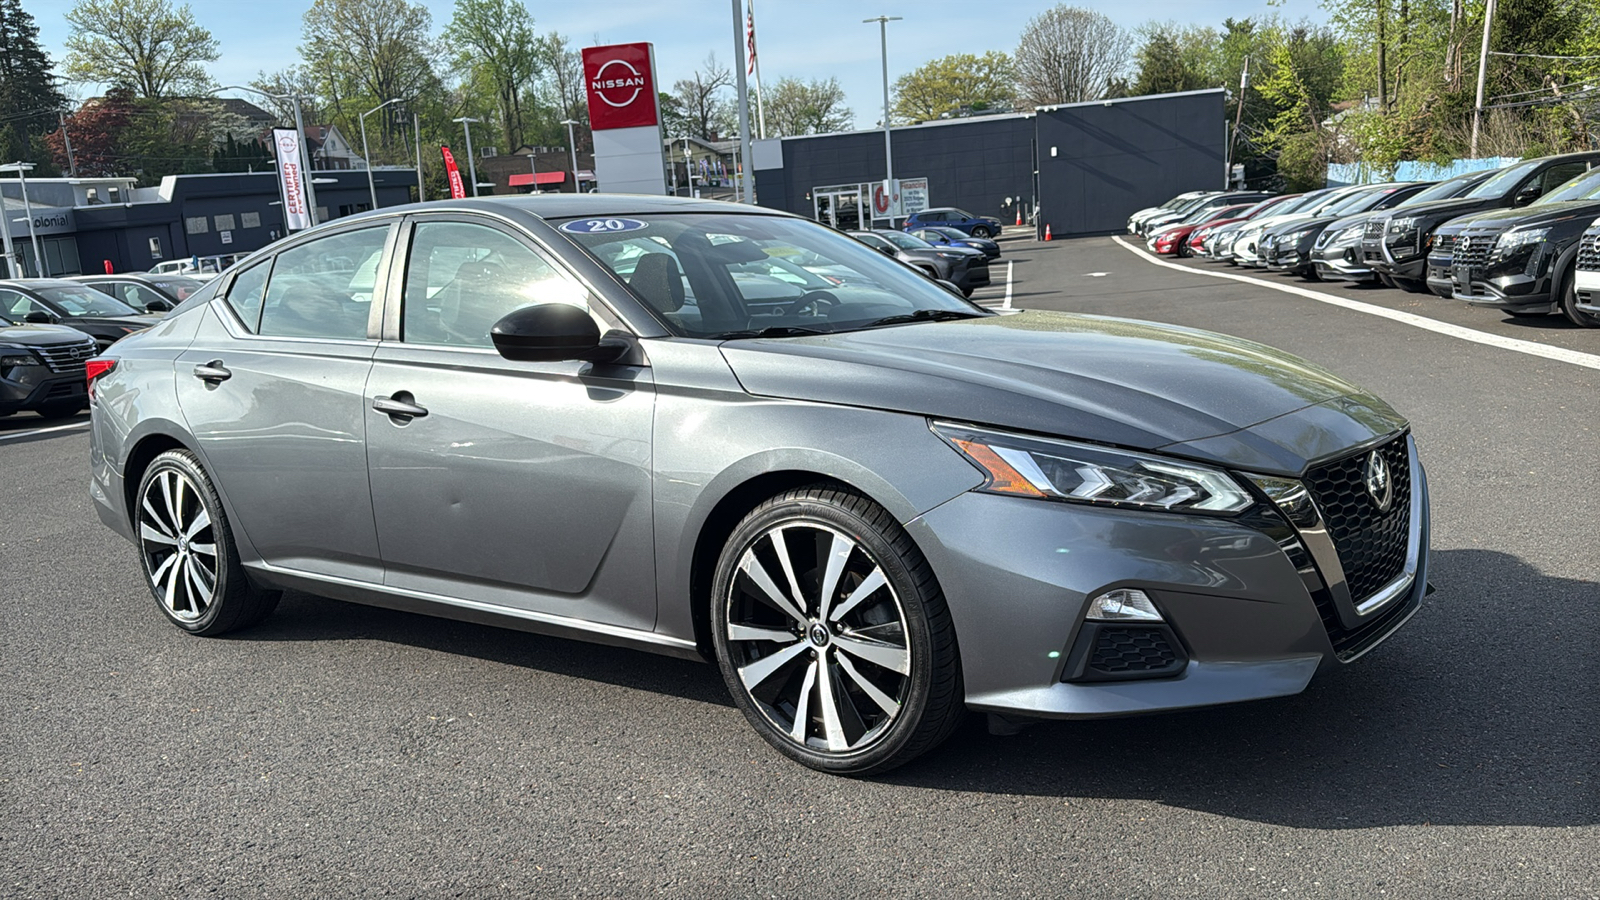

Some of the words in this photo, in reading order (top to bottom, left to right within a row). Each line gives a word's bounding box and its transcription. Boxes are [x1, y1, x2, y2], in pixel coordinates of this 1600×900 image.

[592, 77, 644, 90] NISSAN
[283, 162, 297, 214] CERTIFIED
[587, 219, 625, 231] 20
